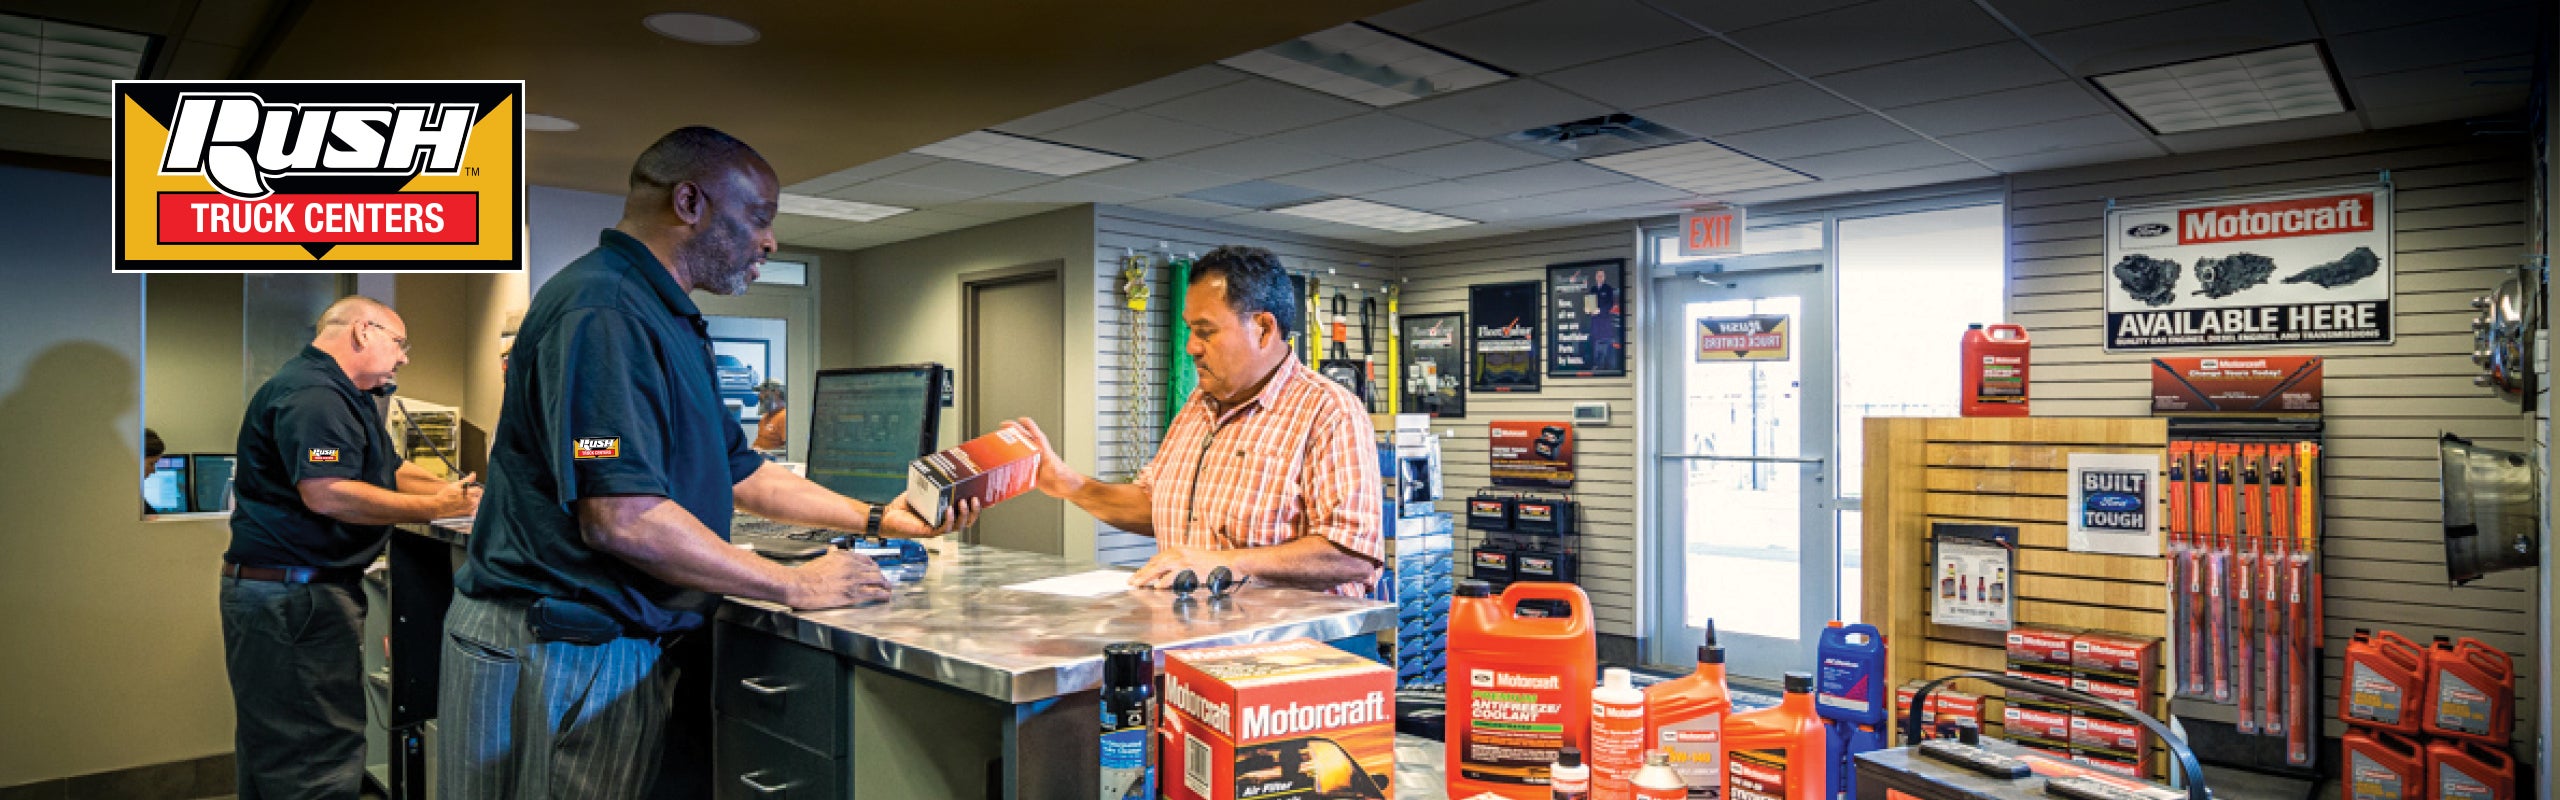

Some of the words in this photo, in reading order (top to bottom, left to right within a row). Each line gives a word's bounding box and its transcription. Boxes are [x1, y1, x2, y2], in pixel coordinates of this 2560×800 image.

[2185, 199, 2363, 240] Motorcraft
[1689, 215, 1733, 248] EXIT
[2118, 307, 2279, 337] AVAILABLE
[2288, 302, 2377, 331] HERE
[578, 438, 615, 450] RUSH
[2086, 473, 2144, 492] BUILT
[2085, 511, 2144, 528] TOUGH
[1496, 673, 1559, 689] Motorcraft
[1242, 690, 1390, 740] Motorcraft
[1472, 709, 1538, 722] COOLANT
[1242, 787, 1260, 797] Air
[1263, 781, 1293, 793] Filter
